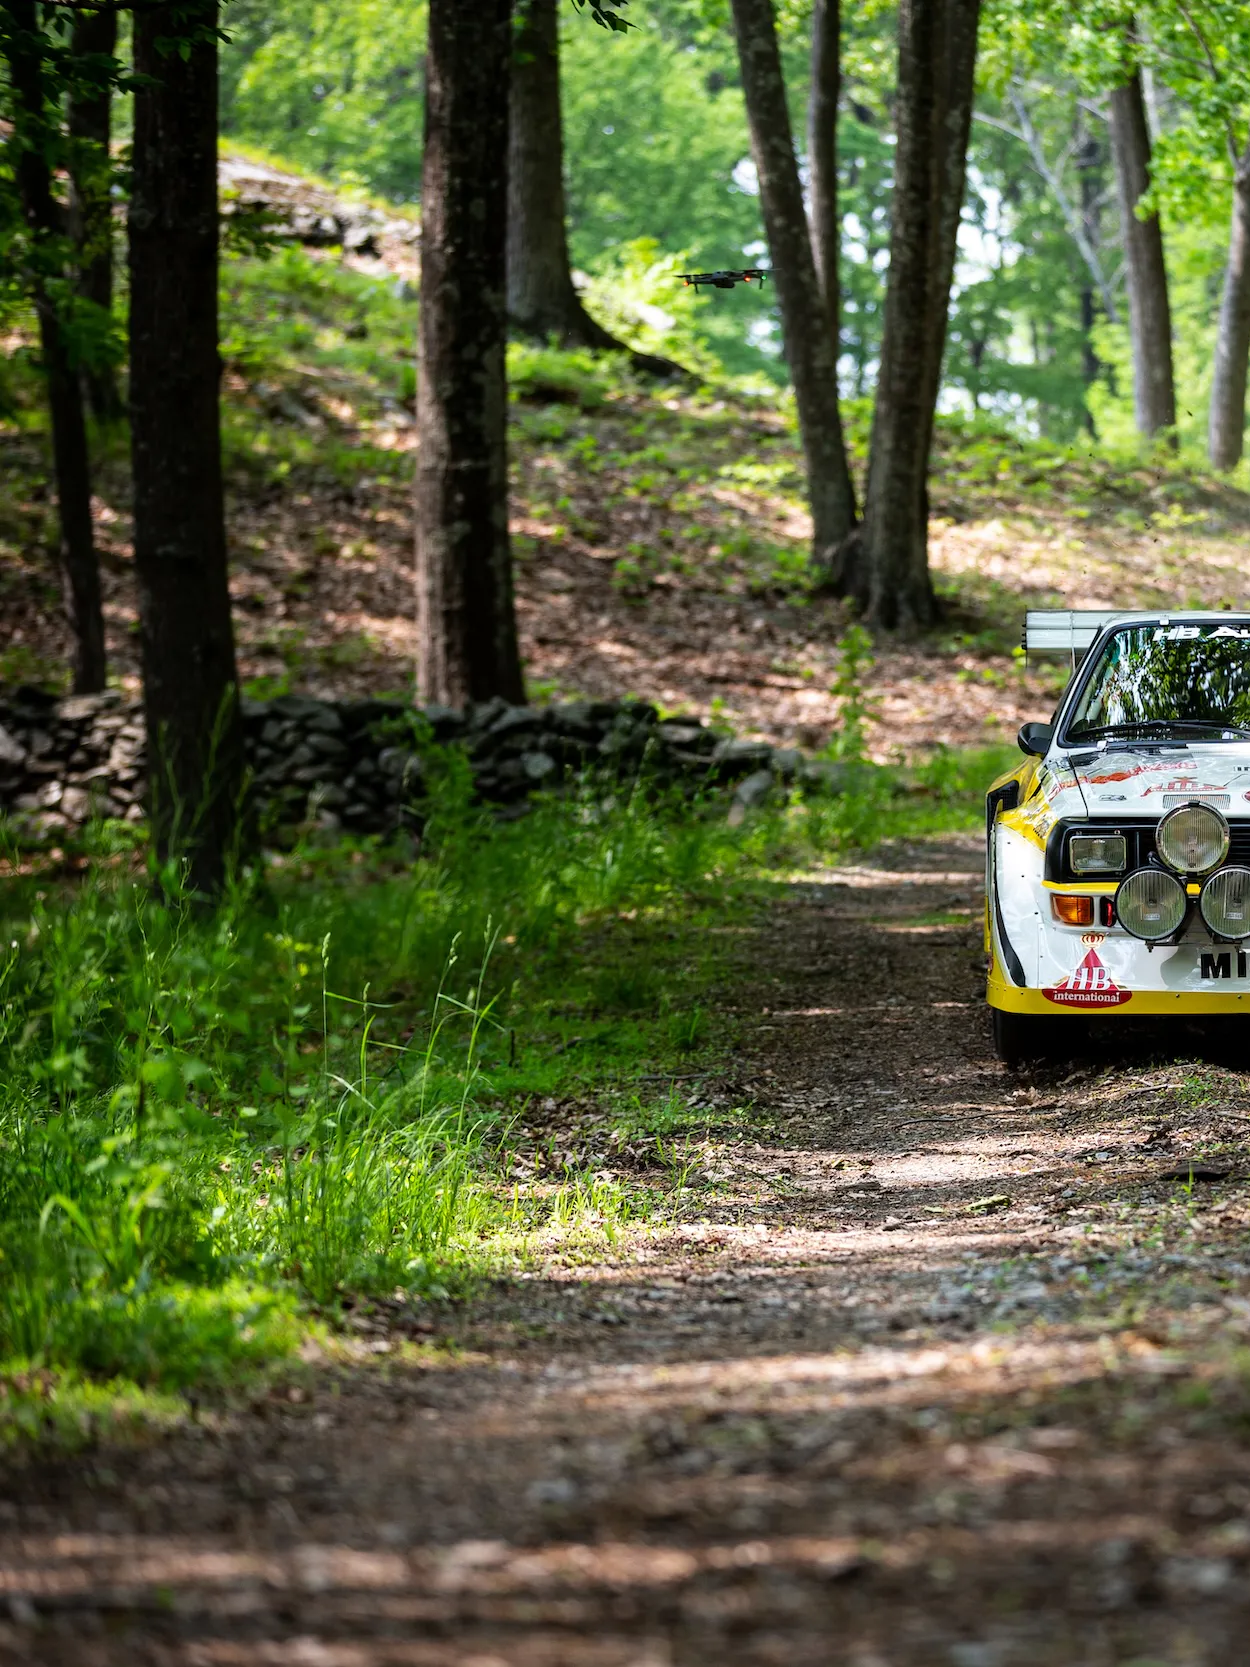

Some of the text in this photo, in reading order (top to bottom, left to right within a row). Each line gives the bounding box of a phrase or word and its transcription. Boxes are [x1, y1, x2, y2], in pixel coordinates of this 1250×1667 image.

[1152, 627, 1200, 640] HB
[1065, 965, 1111, 990] HB
[1053, 990, 1120, 1002] international
